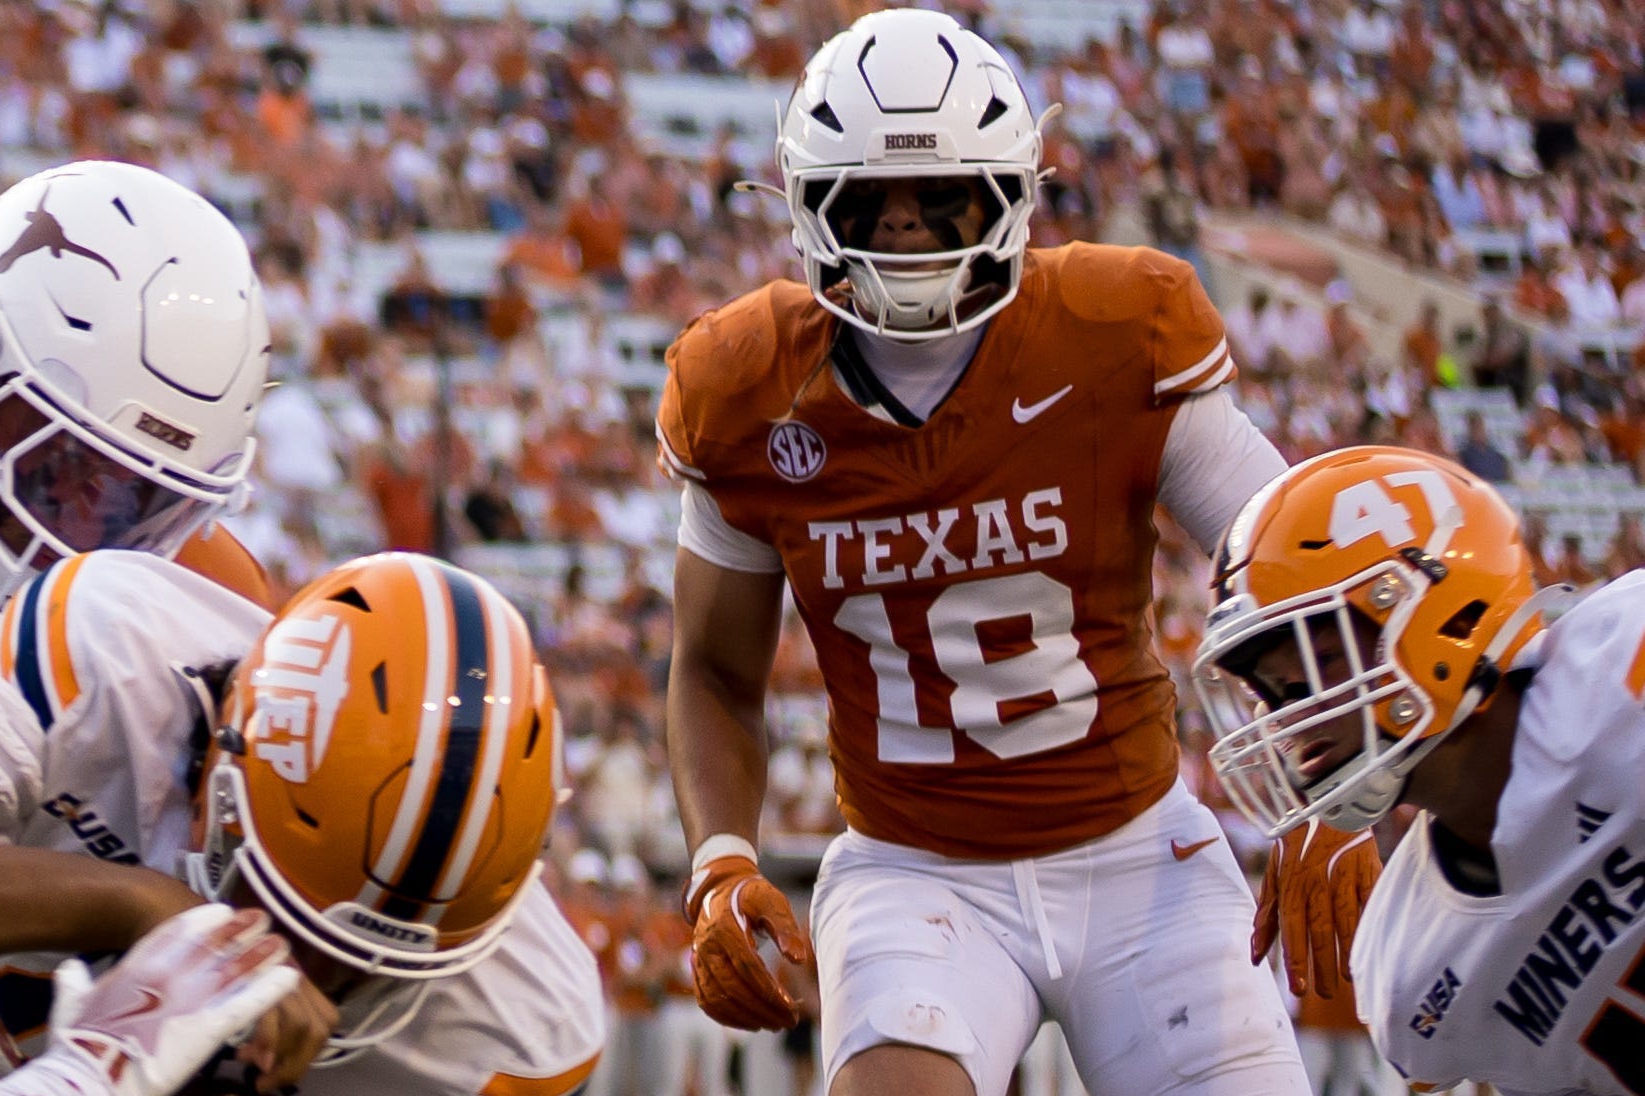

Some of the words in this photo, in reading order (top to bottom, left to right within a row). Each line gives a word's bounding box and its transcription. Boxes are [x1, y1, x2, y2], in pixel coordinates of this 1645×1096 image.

[883, 134, 937, 150] HORNS
[772, 424, 824, 478] SEC
[808, 486, 1068, 589] TEXAS
[1328, 470, 1464, 555] 47
[250, 614, 351, 783] UTEP
[833, 571, 1098, 763] 18
[349, 911, 430, 945] UNITY
[1493, 846, 1645, 1046] MINERS
